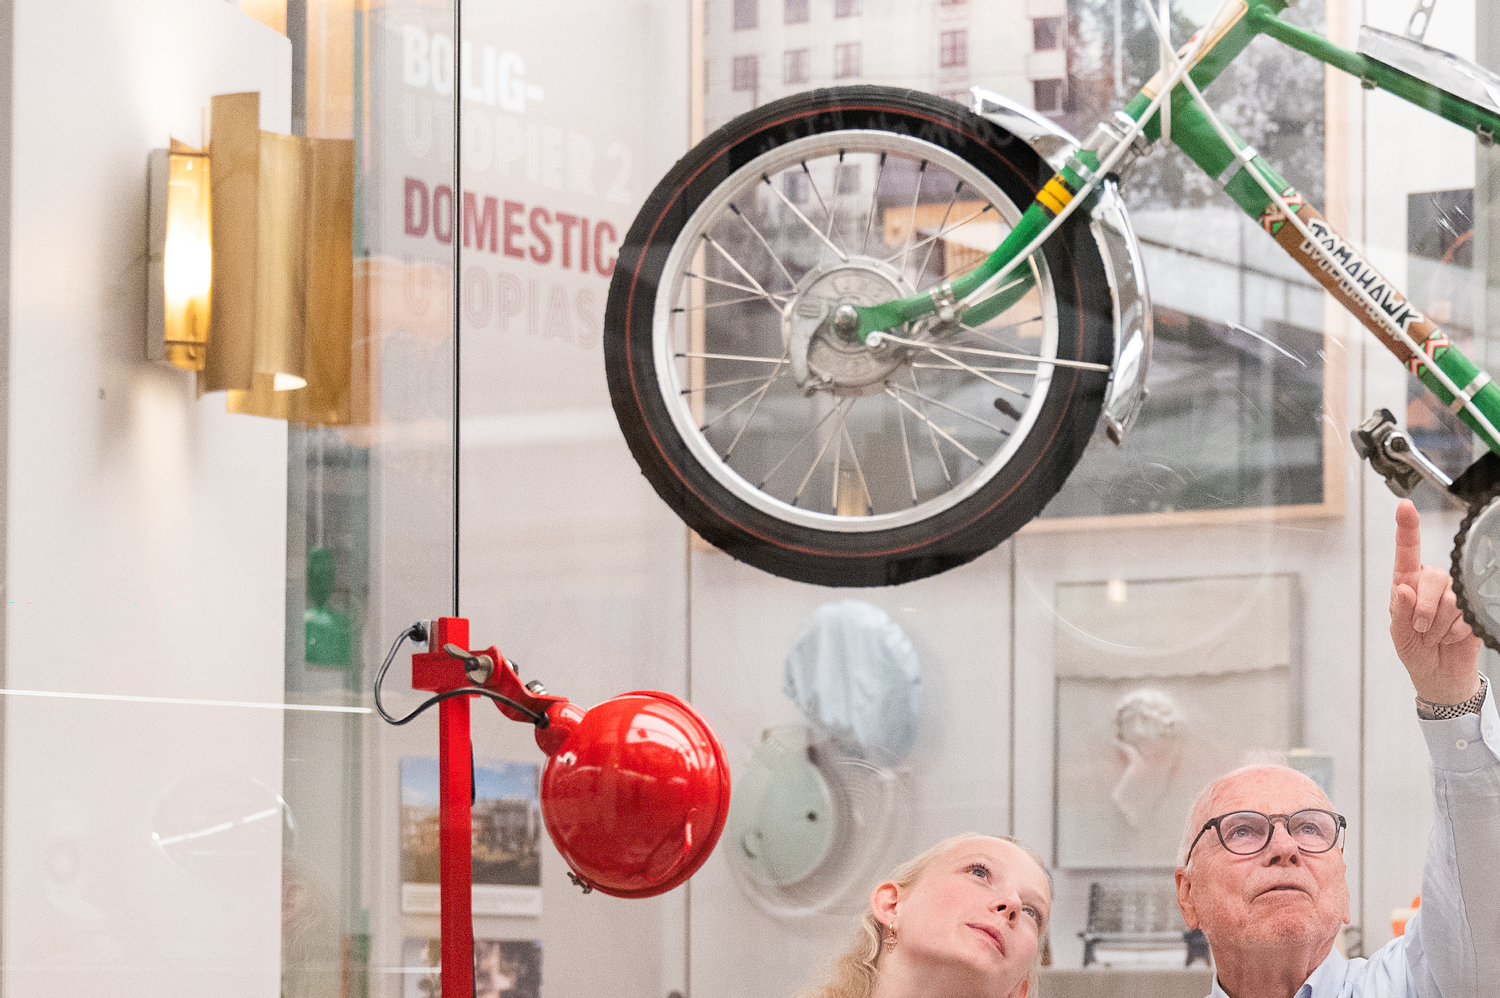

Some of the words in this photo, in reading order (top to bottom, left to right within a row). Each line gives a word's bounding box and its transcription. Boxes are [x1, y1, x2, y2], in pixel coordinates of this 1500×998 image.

[403, 24, 544, 113] BOLIG-
[606, 141, 634, 206] 2
[404, 177, 618, 277] DOMESTIC
[403, 260, 600, 350] UOPIAS
[1299, 217, 1423, 341] TOMAHAWK
